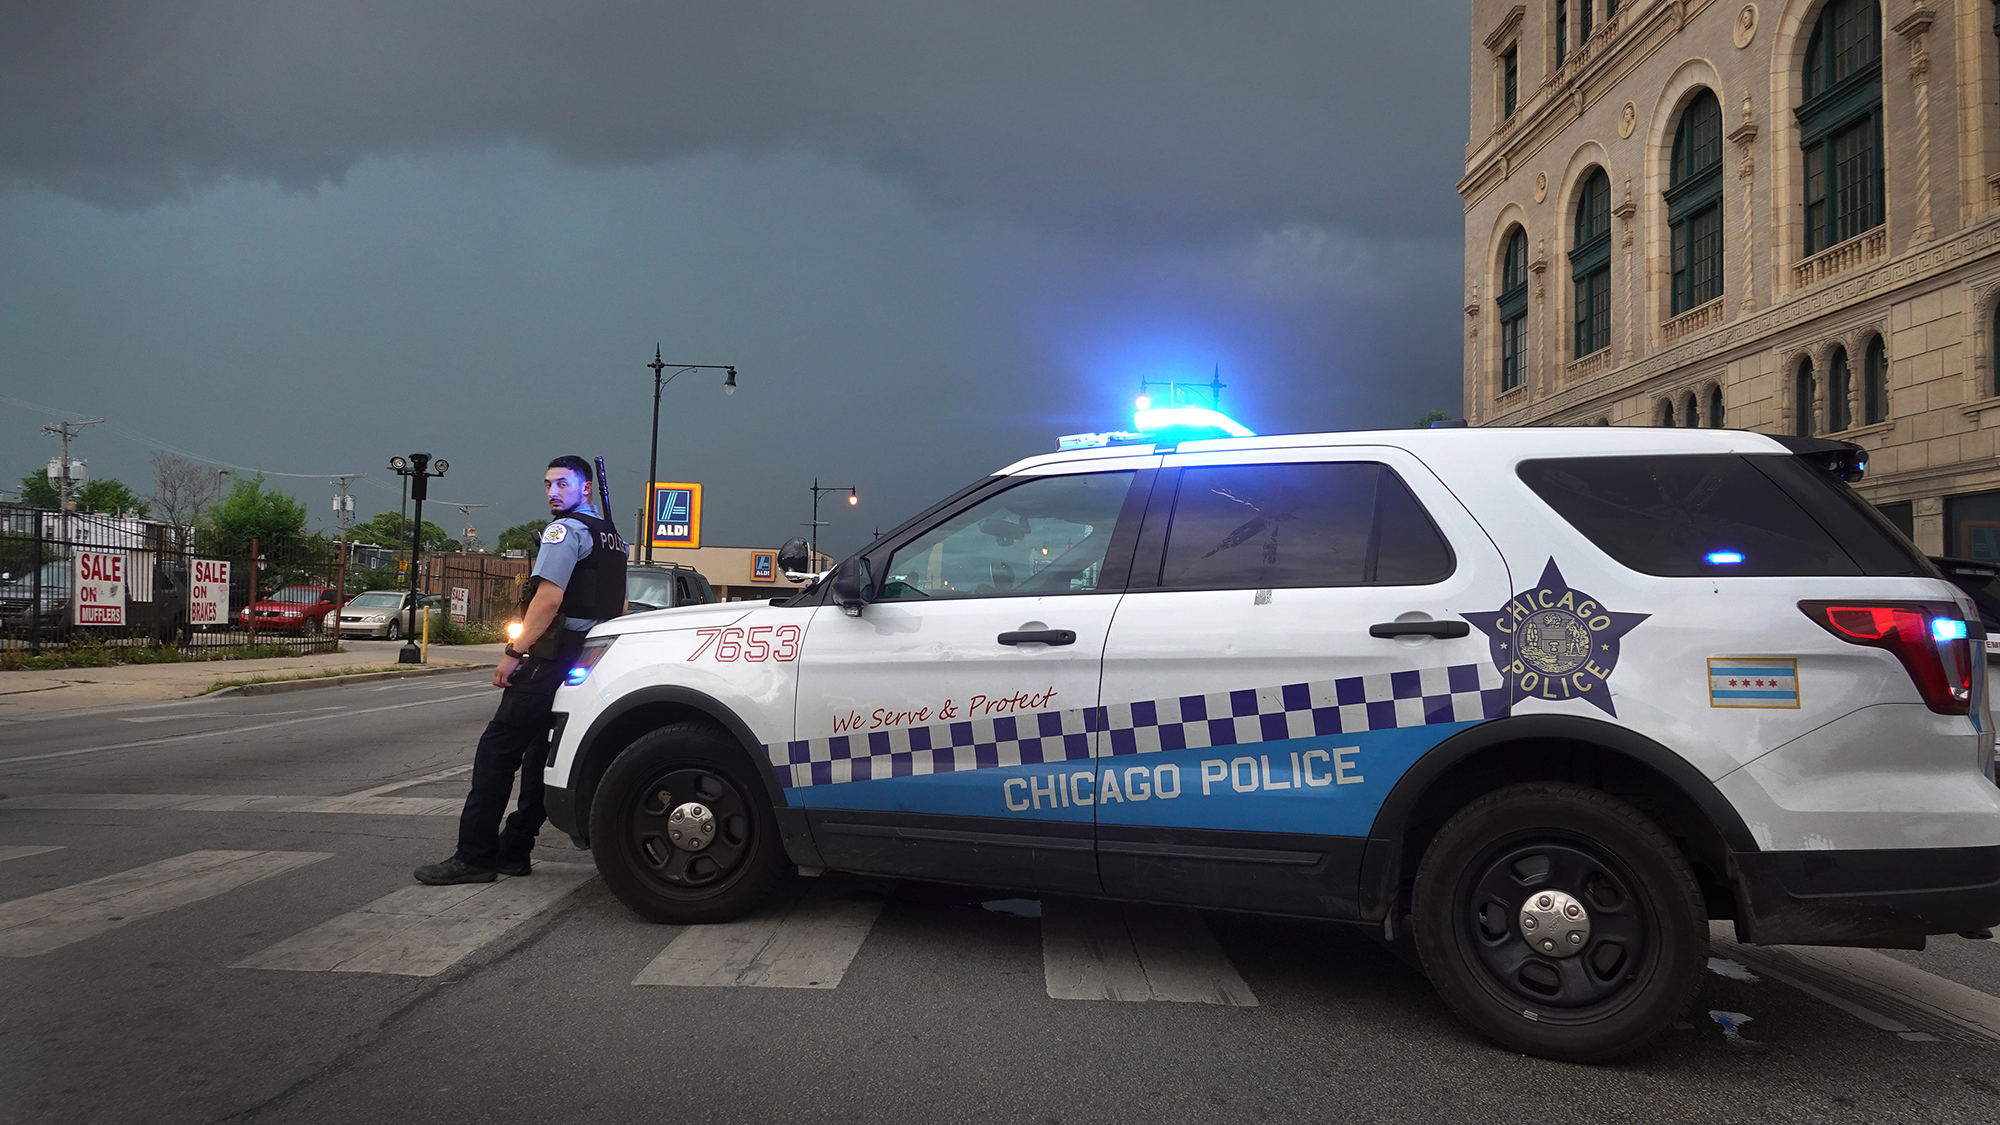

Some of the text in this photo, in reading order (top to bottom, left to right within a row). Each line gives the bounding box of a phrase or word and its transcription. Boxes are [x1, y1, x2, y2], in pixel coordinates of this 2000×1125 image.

[656, 524, 689, 536] ALDI
[599, 532, 627, 554] POL
[81, 553, 122, 582] SALE
[195, 561, 227, 583] SALE
[81, 586, 97, 602] ON
[193, 586, 207, 599] ON
[452, 589, 465, 602] SALE
[82, 607, 121, 623] MUFFLERS
[192, 602, 217, 622] BRAKES
[1496, 589, 1611, 633] CHICAGO
[686, 625, 801, 662] 7653
[1502, 659, 1610, 699] POLICE
[833, 686, 1058, 734] We Serve & Protect
[1003, 746, 1365, 812] CHICAGO POLICE
